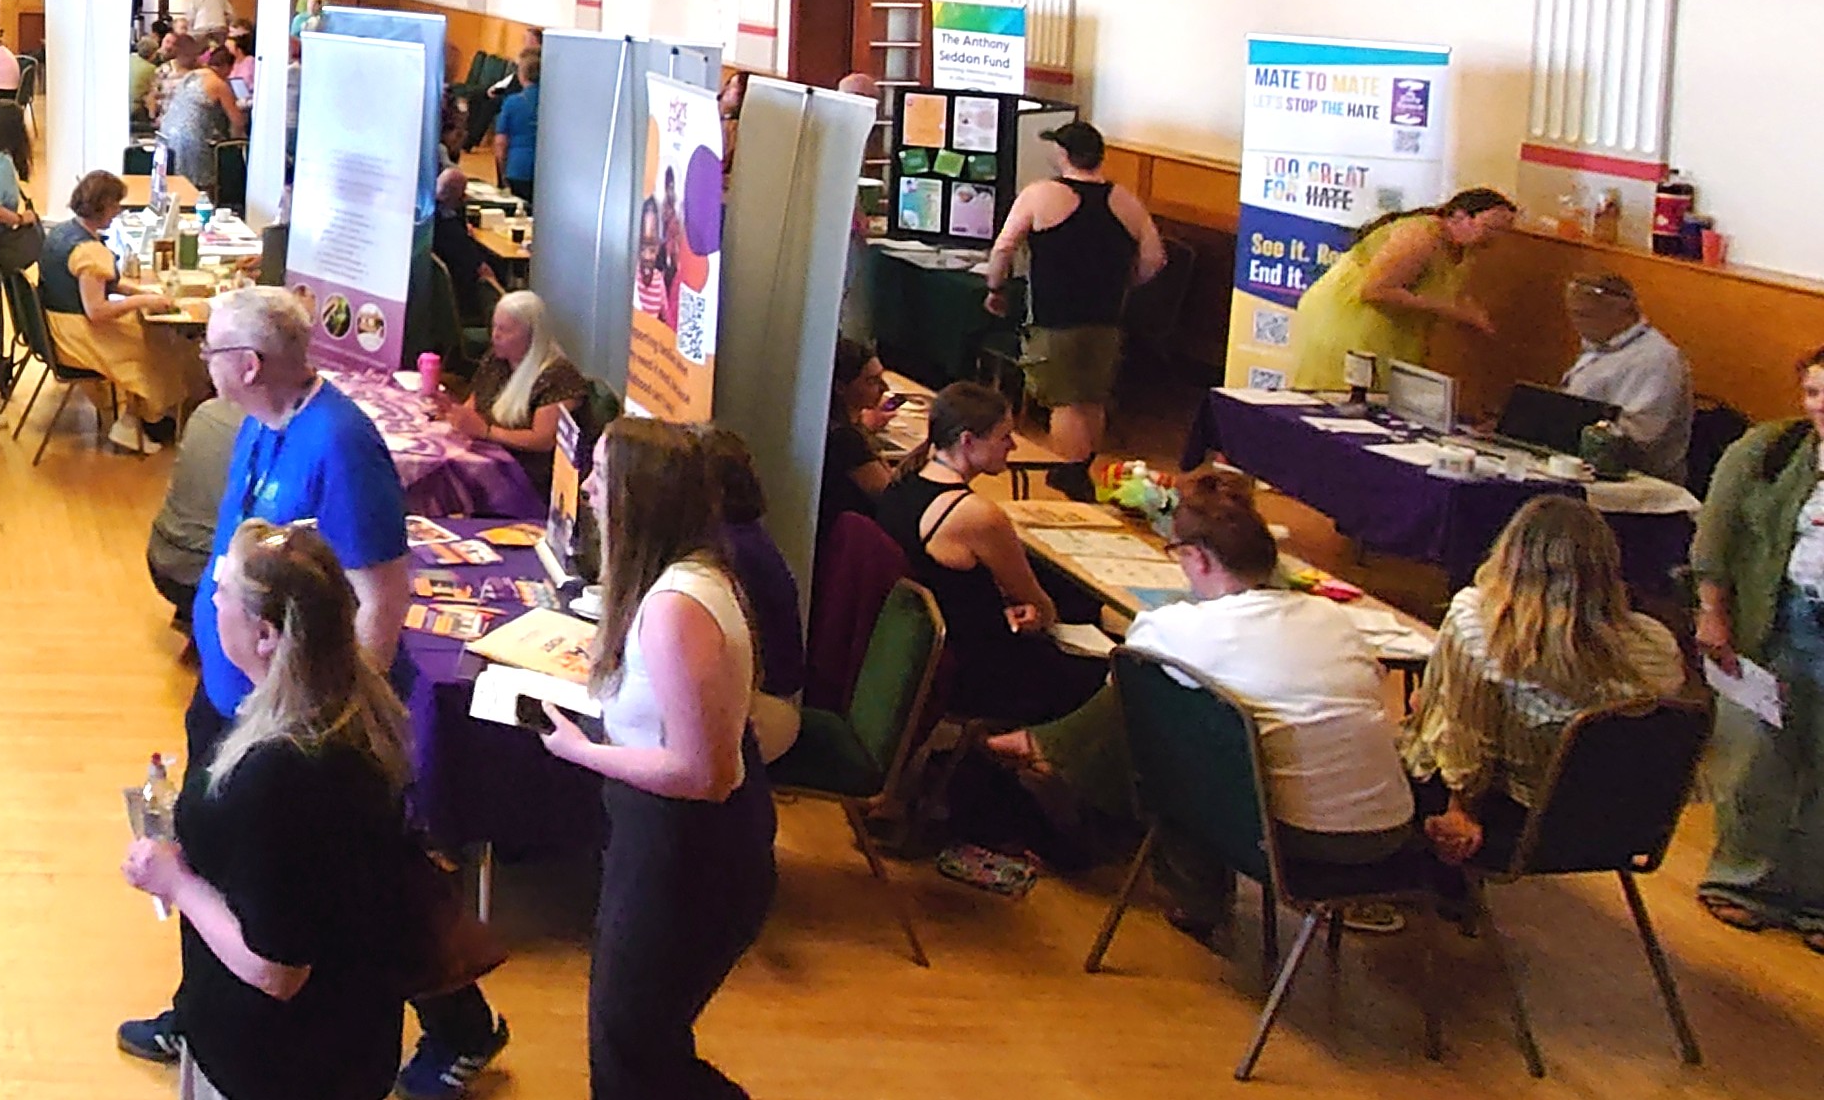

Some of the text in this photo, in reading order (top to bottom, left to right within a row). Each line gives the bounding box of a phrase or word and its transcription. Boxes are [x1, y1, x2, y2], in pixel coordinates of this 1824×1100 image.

[942, 33, 1010, 53] The Anthony
[939, 50, 1010, 69] Seddon Fund
[1254, 67, 1380, 97] MATE TO MATE
[1285, 97, 1318, 113] STOP
[1321, 100, 1344, 117] THE
[1347, 103, 1380, 121] HATE
[1264, 156, 1370, 189] TOO GREAT
[1263, 178, 1354, 212] FOR HATE
[1251, 232, 1285, 259] See
[1249, 259, 1308, 290] End it.
